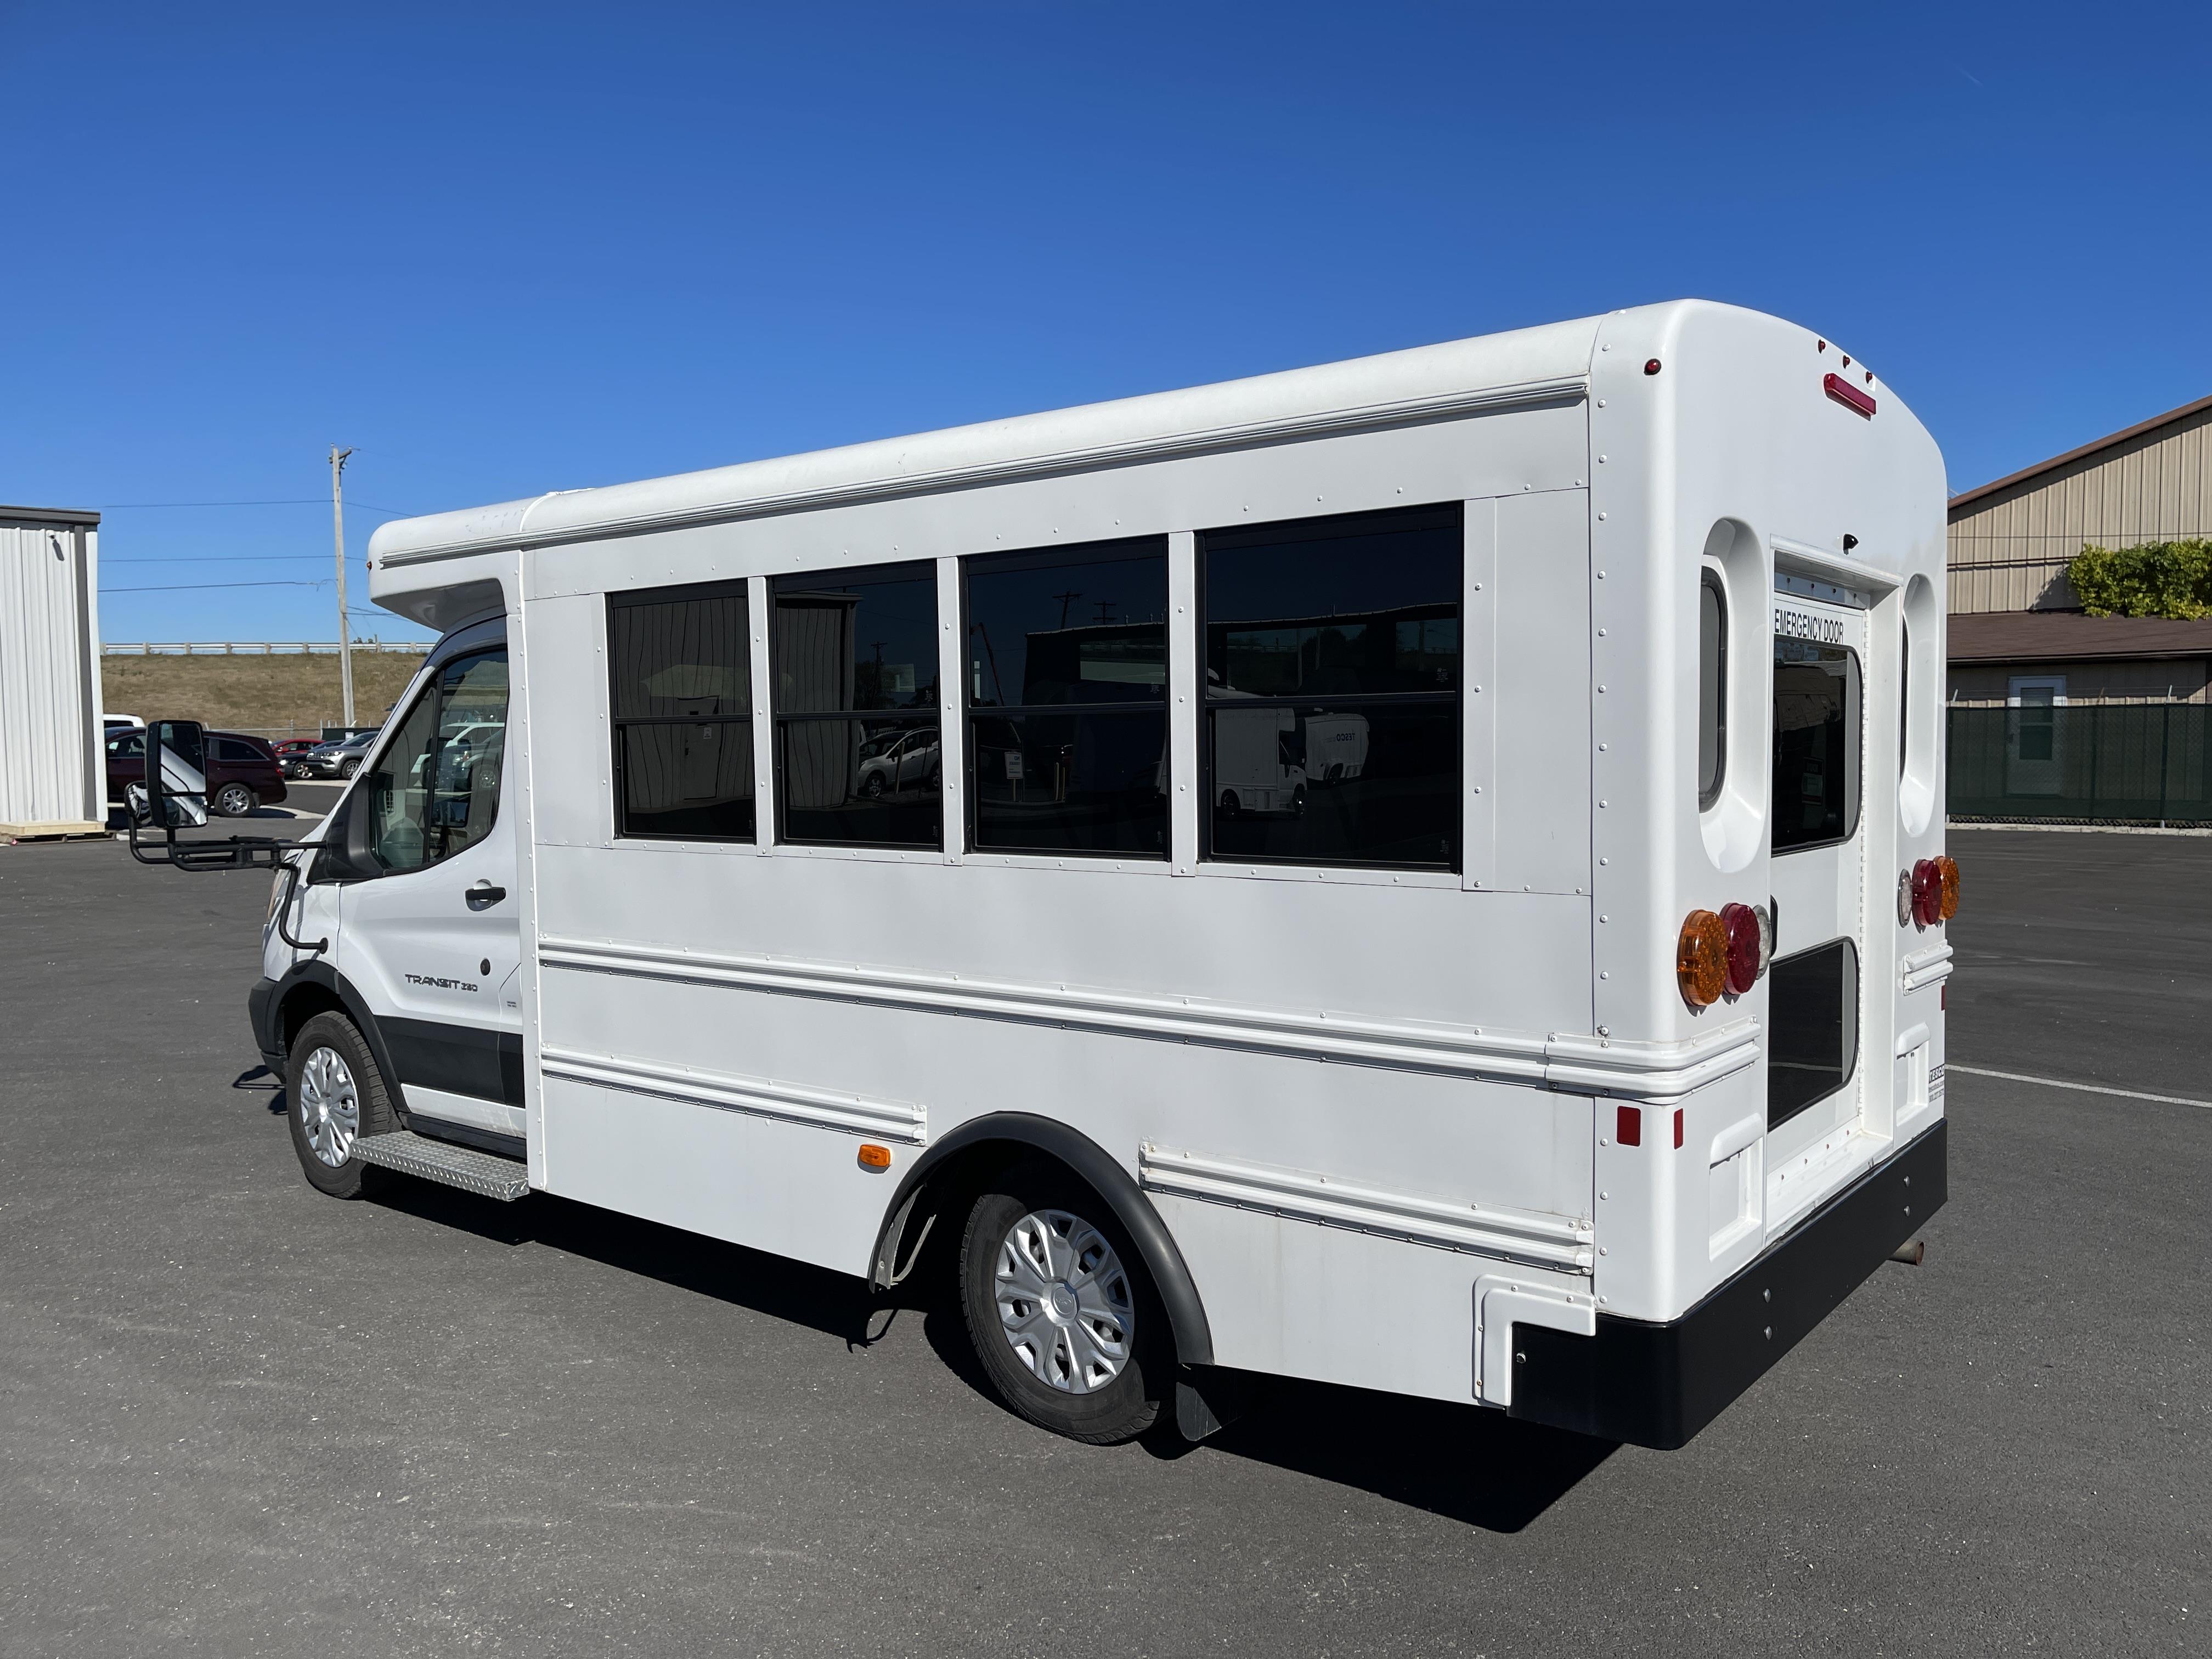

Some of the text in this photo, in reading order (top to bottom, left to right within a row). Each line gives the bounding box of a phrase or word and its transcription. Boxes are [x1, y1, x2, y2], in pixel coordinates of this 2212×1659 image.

[1775, 608, 1844, 644] EMERGENCY DOOR
[405, 974, 460, 990] TRANSIT
[1929, 1065, 1945, 1081] TESCO
